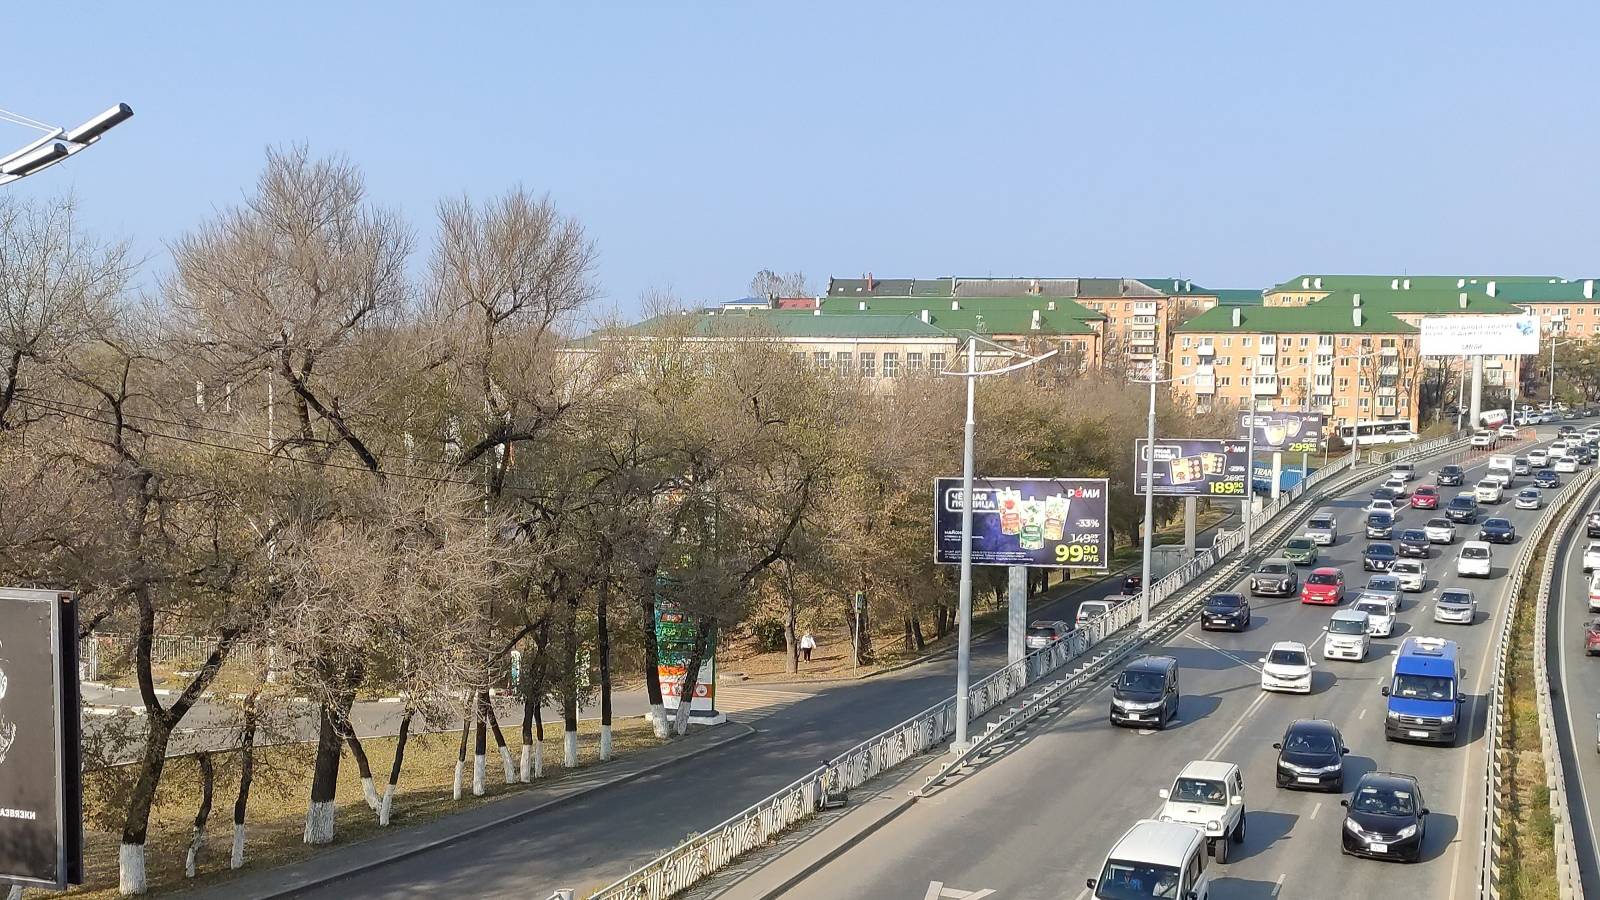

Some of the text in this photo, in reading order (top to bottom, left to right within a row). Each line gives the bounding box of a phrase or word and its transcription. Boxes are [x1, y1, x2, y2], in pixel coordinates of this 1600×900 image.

[1208, 482, 1234, 494] 189
[1076, 519, 1099, 528] -33%
[1055, 544, 1100, 563] 99 90 РУБ
